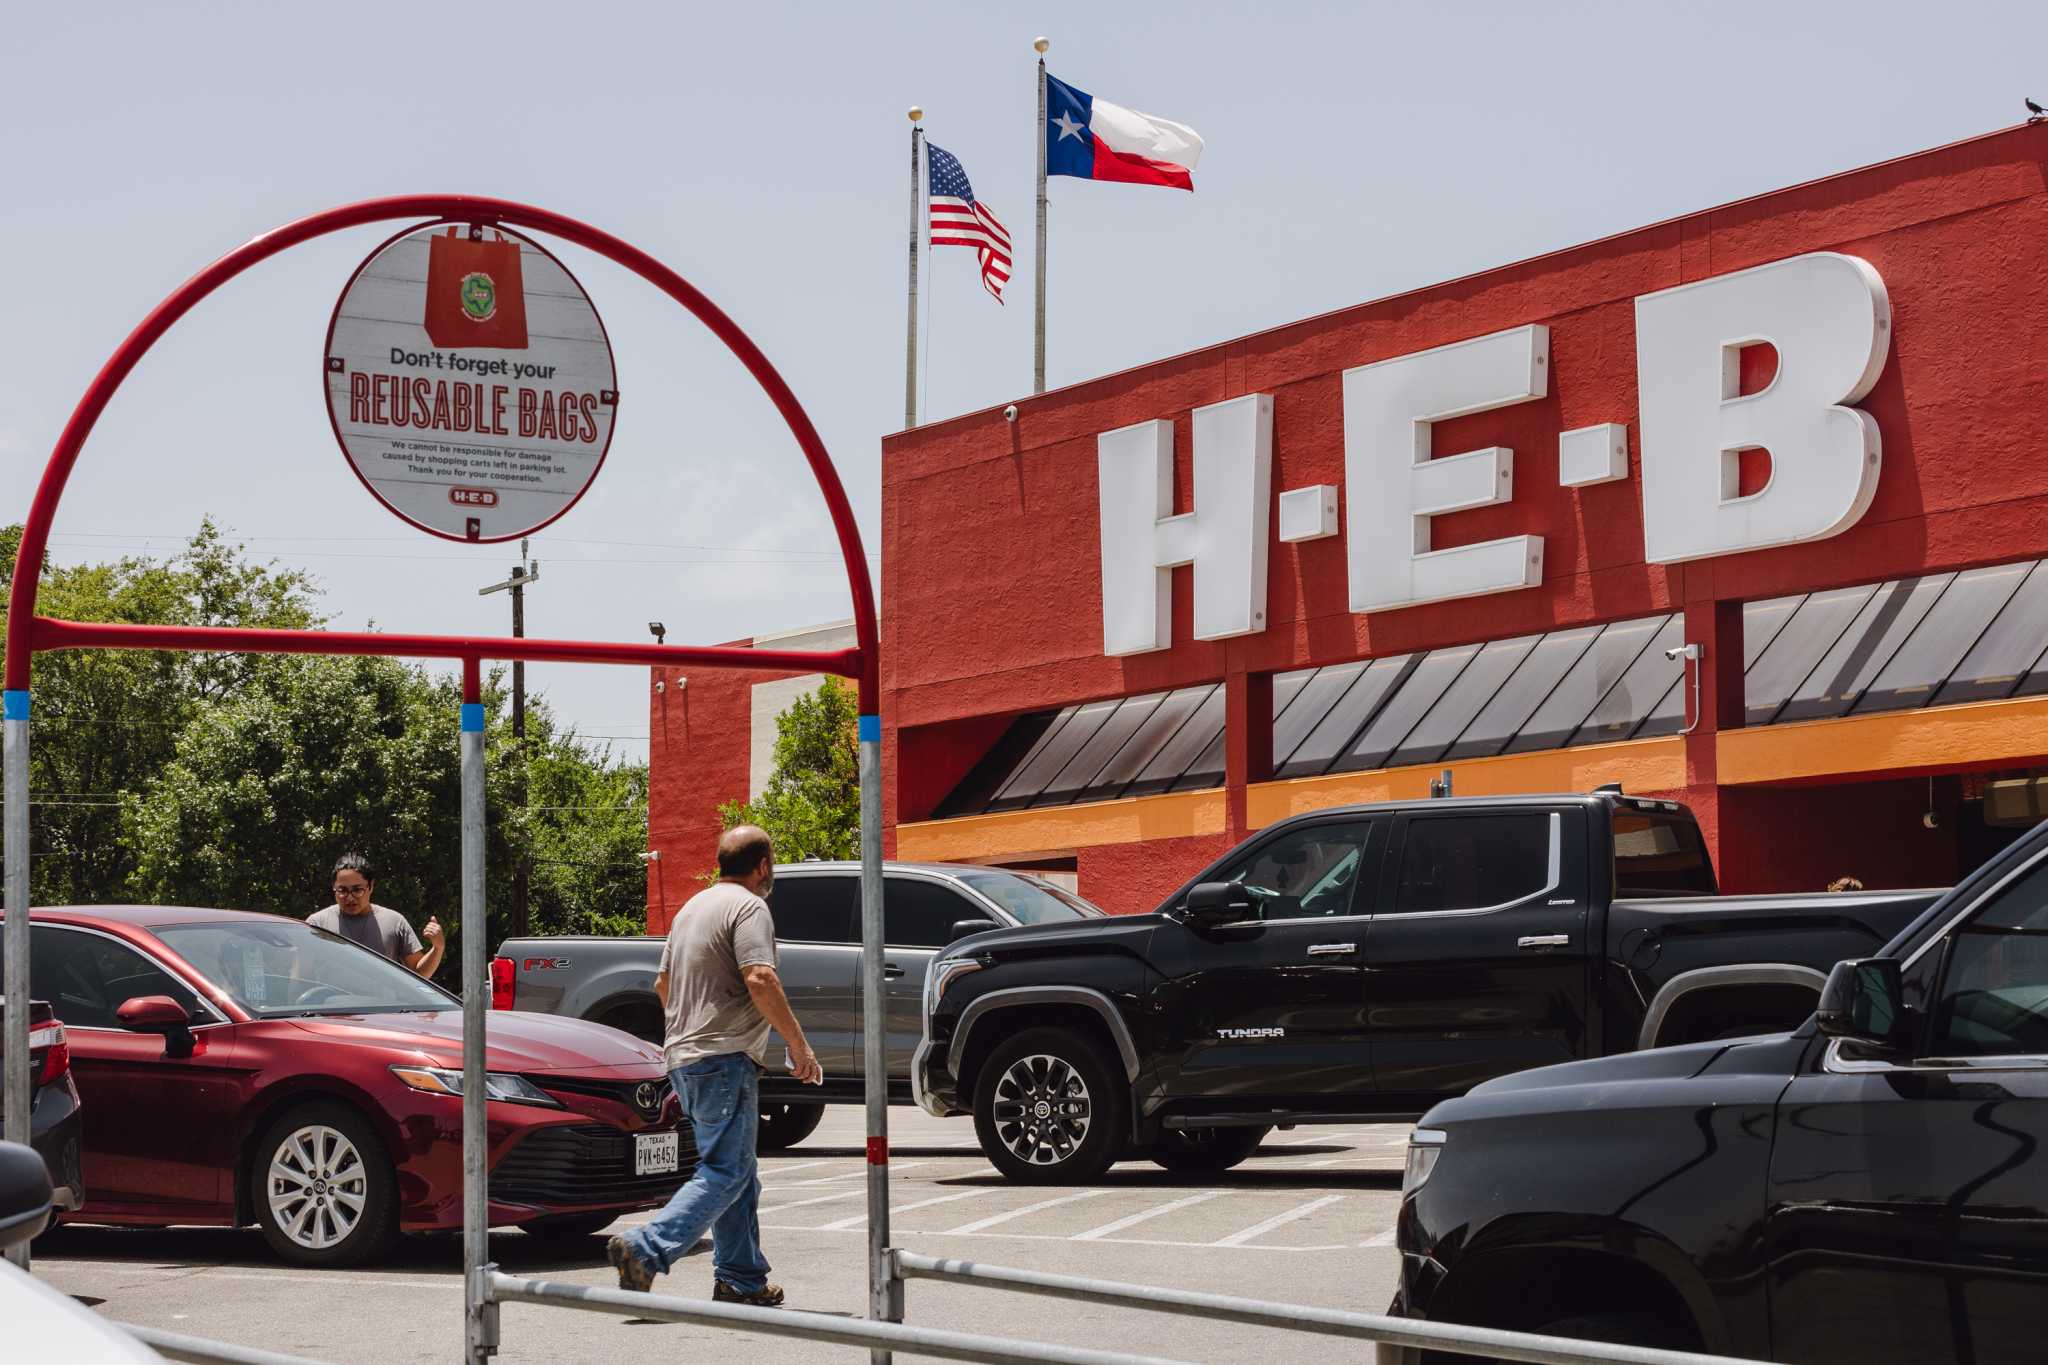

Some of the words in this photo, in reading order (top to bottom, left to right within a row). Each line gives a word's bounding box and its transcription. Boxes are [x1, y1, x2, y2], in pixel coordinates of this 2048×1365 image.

[391, 348, 443, 369] Don't
[449, 353, 508, 376] forget
[513, 362, 556, 379] your
[350, 372, 509, 436] REUSABLE
[519, 387, 598, 444] BAGS
[391, 441, 406, 450] We
[408, 443, 438, 452] cannot
[440, 445, 451, 453] be
[453, 446, 502, 457] responsible
[504, 449, 517, 458] for
[518, 451, 552, 462] damage
[382, 453, 413, 461] caused
[415, 454, 426, 464] by
[428, 456, 468, 467] shopping
[470, 459, 491, 468] carts
[493, 460, 508, 469] left
[510, 462, 518, 470] in
[520, 462, 552, 474] parking
[553, 465, 567, 474] lot.
[408, 464, 434, 474] Thank
[436, 468, 453, 477] you
[454, 468, 467, 477] for
[468, 470, 488, 479] your
[490, 472, 545, 483] cooperation.
[524, 958, 571, 971] FX2
[1216, 1027, 1285, 1039] TUNDRA
[648, 1135, 665, 1145] TEXAS
